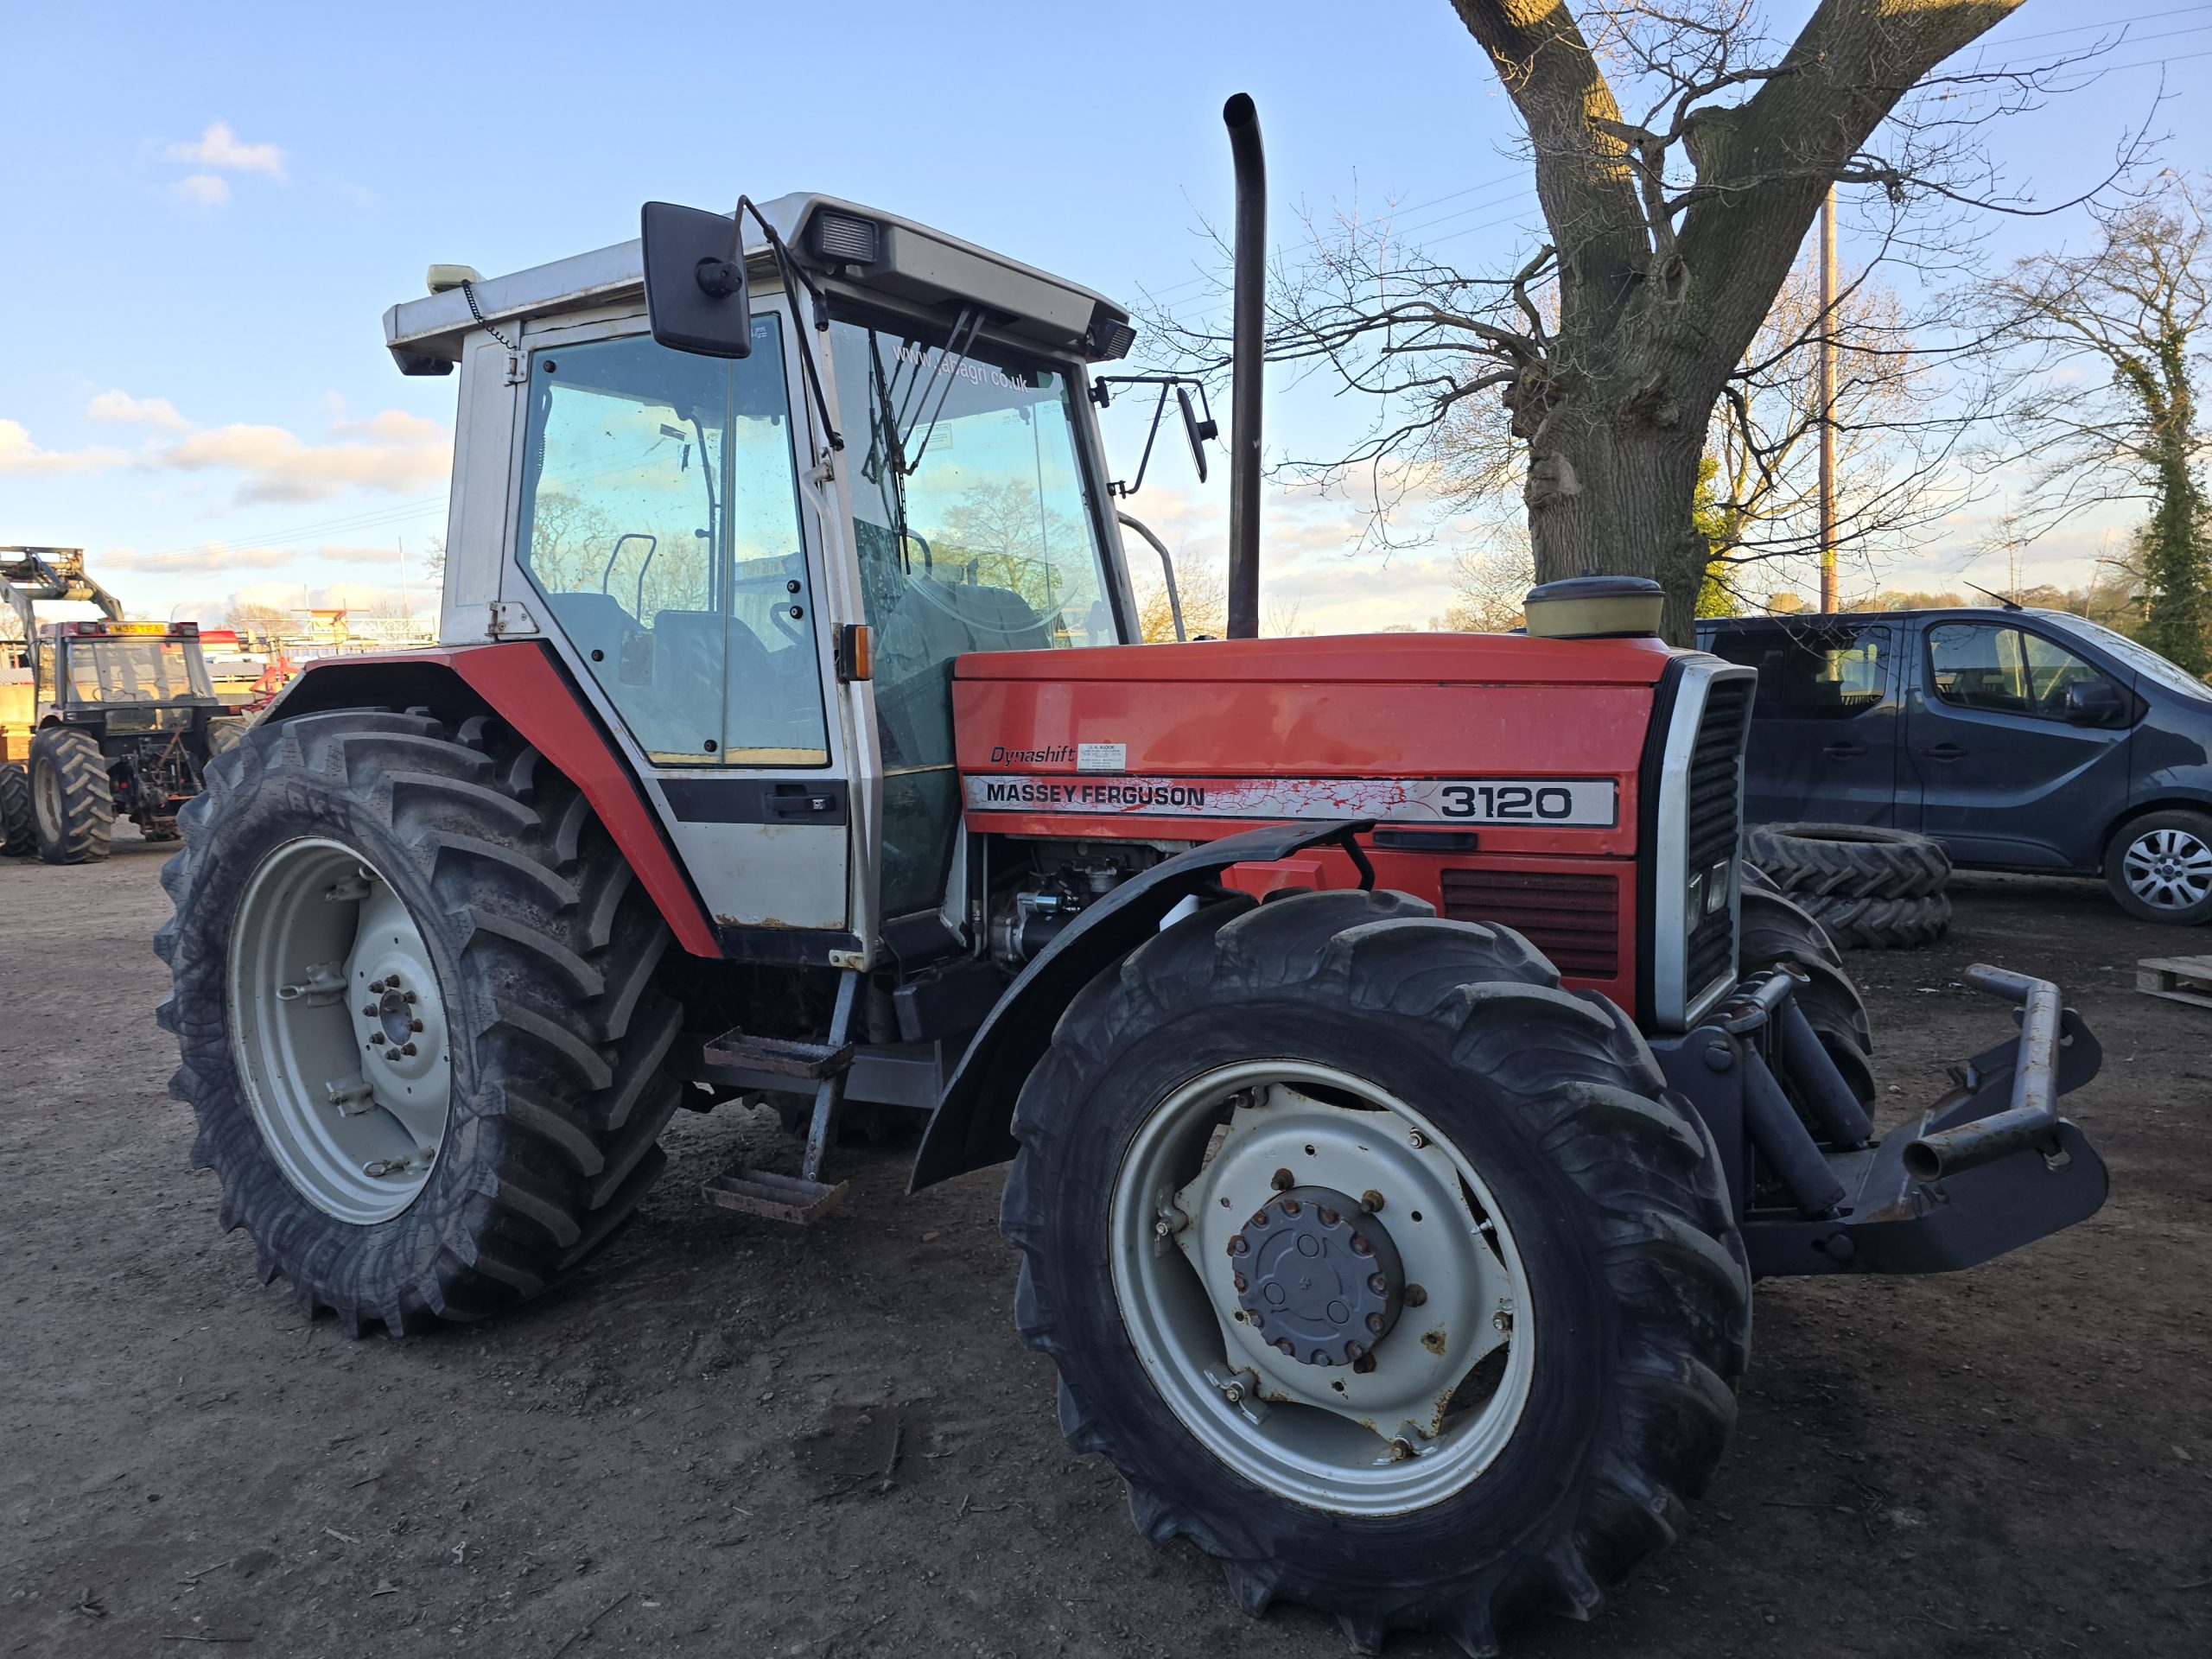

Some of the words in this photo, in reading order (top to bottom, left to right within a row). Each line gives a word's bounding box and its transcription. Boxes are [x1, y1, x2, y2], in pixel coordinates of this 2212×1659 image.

[991, 746, 1077, 767] Dynashift
[987, 784, 1077, 803] MASSEY
[1082, 785, 1205, 806] FERGUSON
[1441, 785, 1572, 819] 3120
